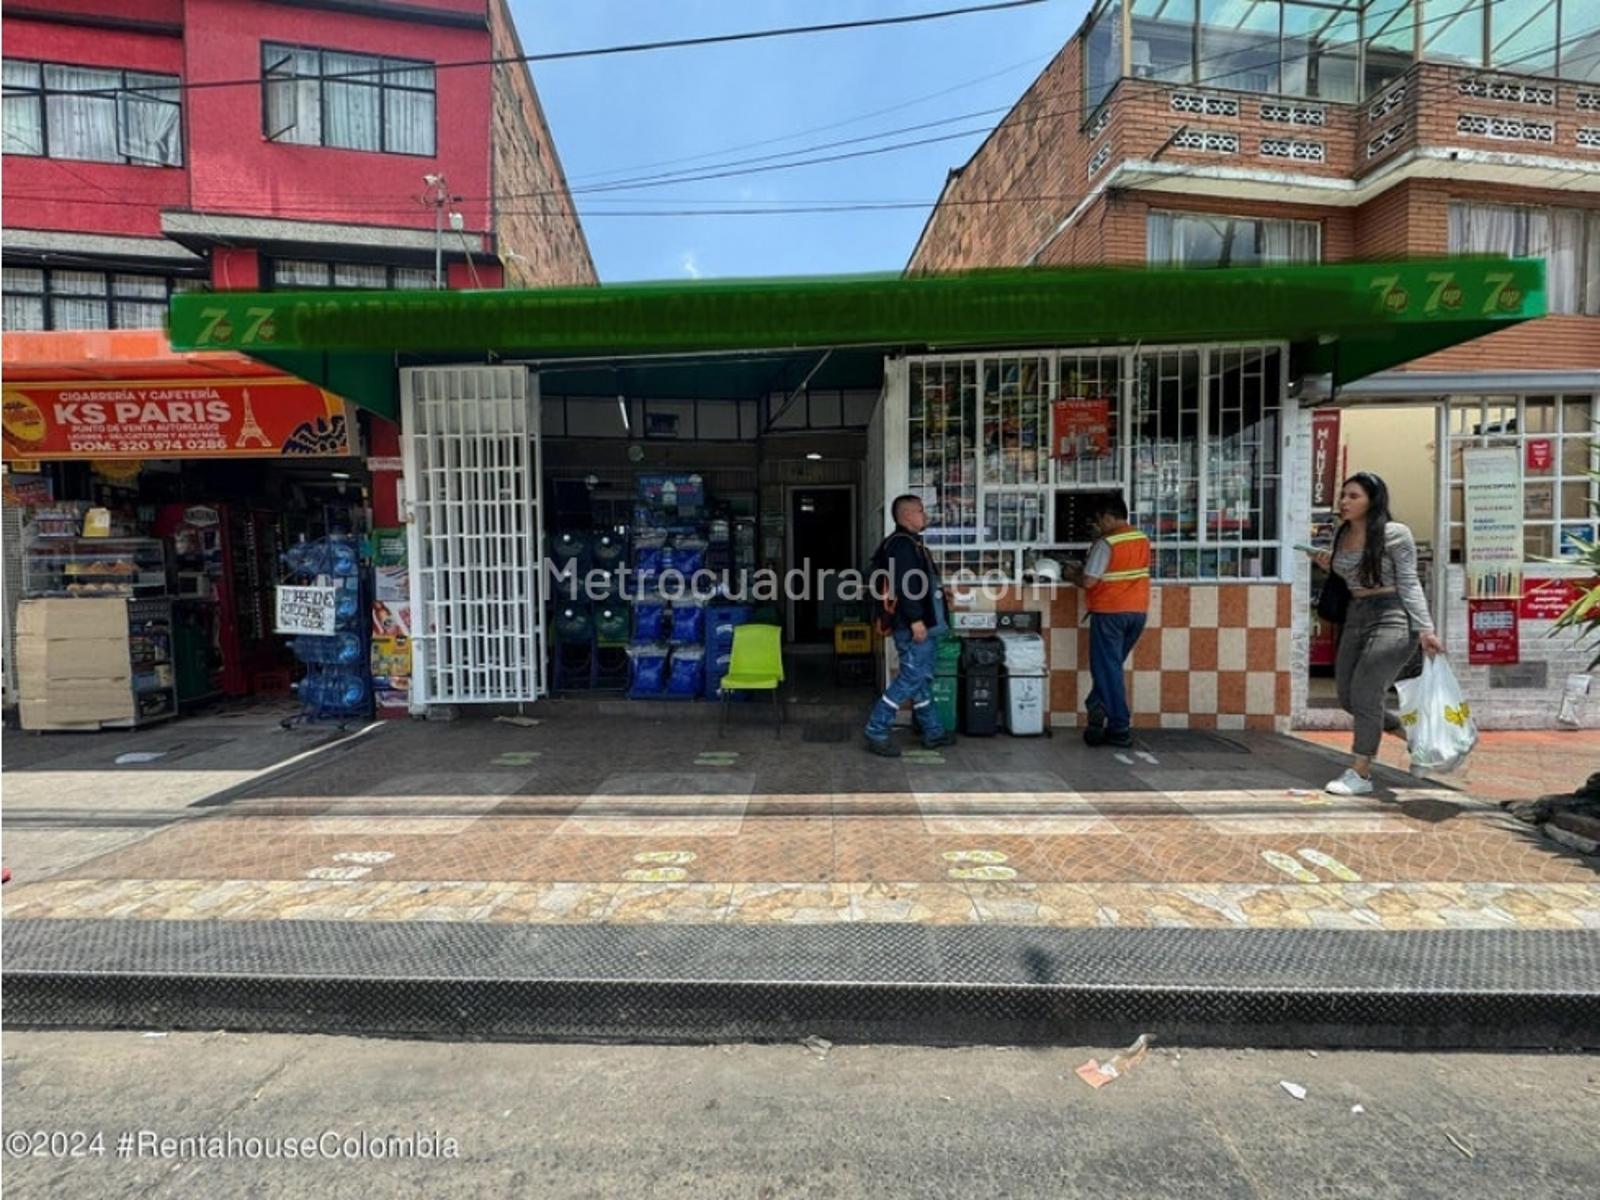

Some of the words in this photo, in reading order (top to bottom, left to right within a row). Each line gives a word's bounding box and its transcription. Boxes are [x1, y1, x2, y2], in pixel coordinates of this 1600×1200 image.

[138, 391, 147, 400] Y
[53, 402, 107, 424] KS
[115, 400, 232, 423] PARIS
[121, 424, 153, 432] VENTA
[70, 441, 117, 451] DOM:
[118, 440, 150, 450] 320
[153, 440, 183, 450] 974
[186, 439, 228, 449] 0286
[1314, 427, 1329, 504] MINUTOS
